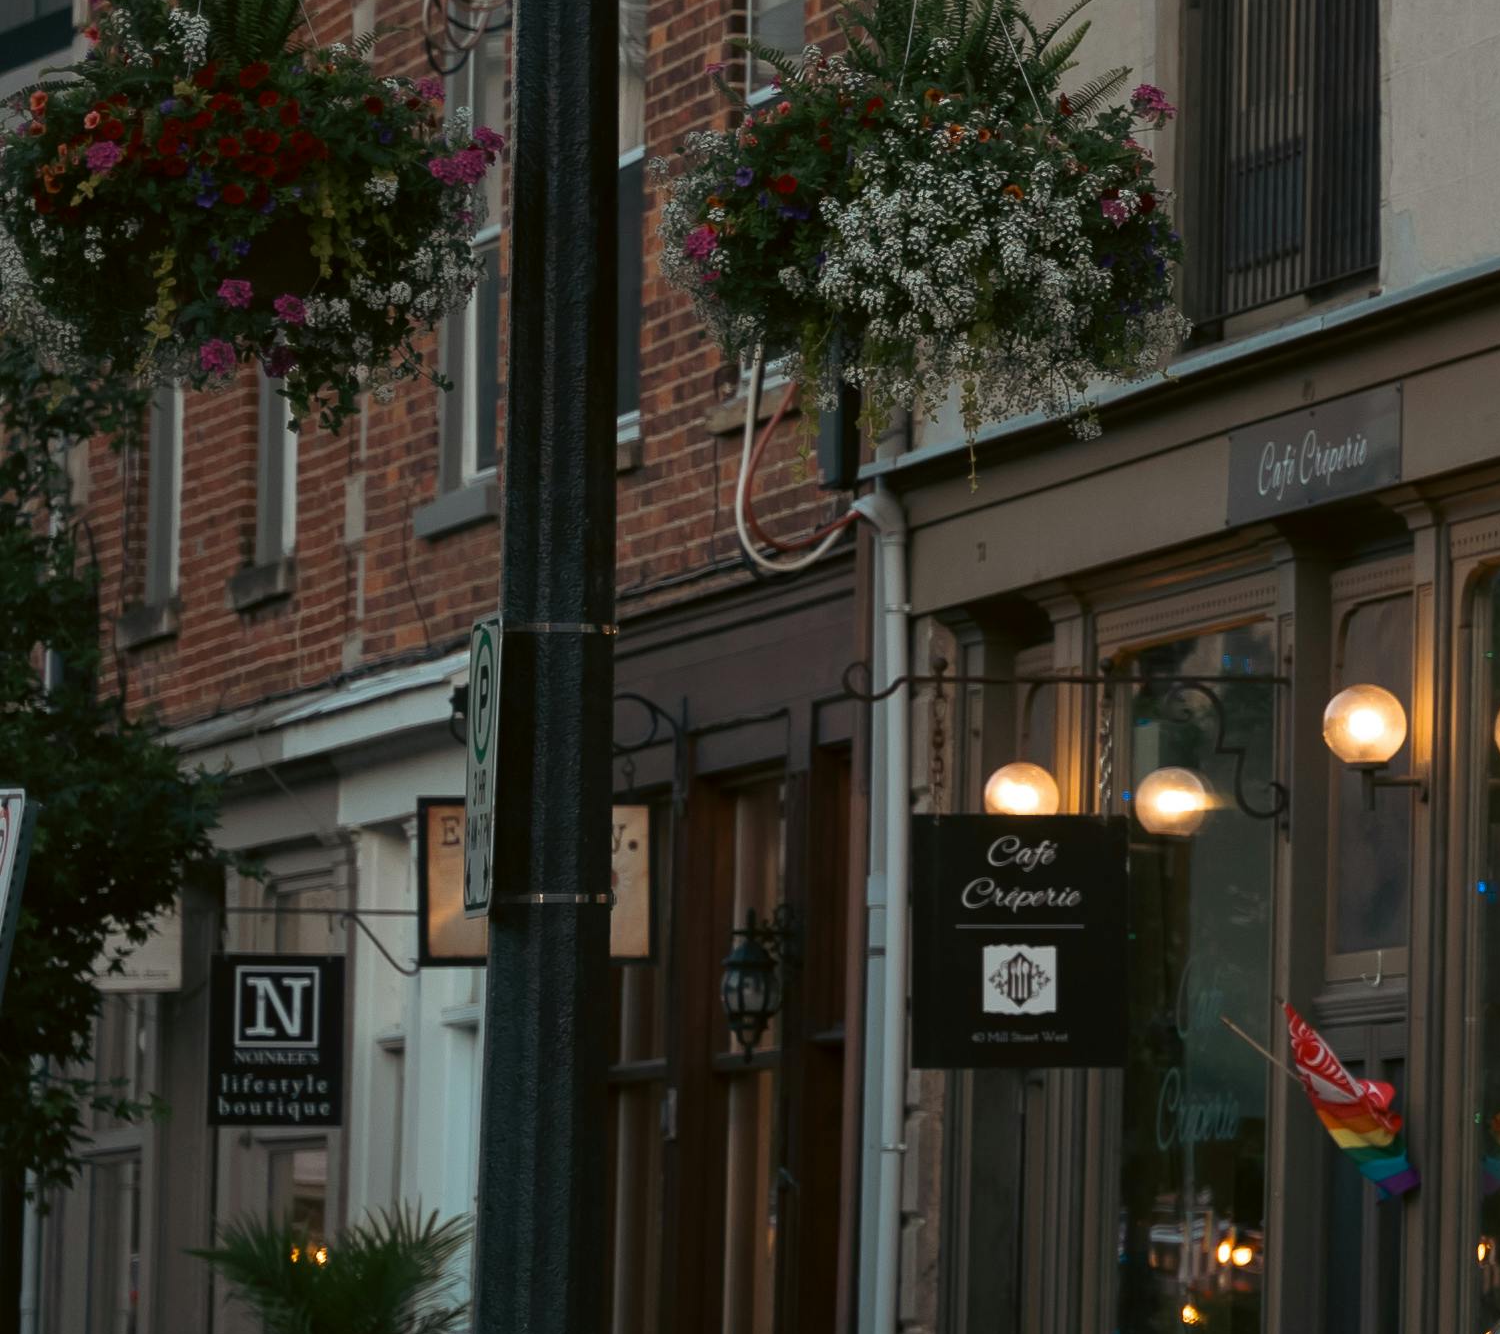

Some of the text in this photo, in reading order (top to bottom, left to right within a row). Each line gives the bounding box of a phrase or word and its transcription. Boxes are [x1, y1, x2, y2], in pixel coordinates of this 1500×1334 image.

[1258, 441, 1297, 501] Café
[987, 835, 1058, 873] Café
[961, 876, 1083, 914] Crêperie
[244, 976, 312, 1038] N
[221, 1073, 328, 1099] lifestyle
[218, 1096, 331, 1122] boutique
